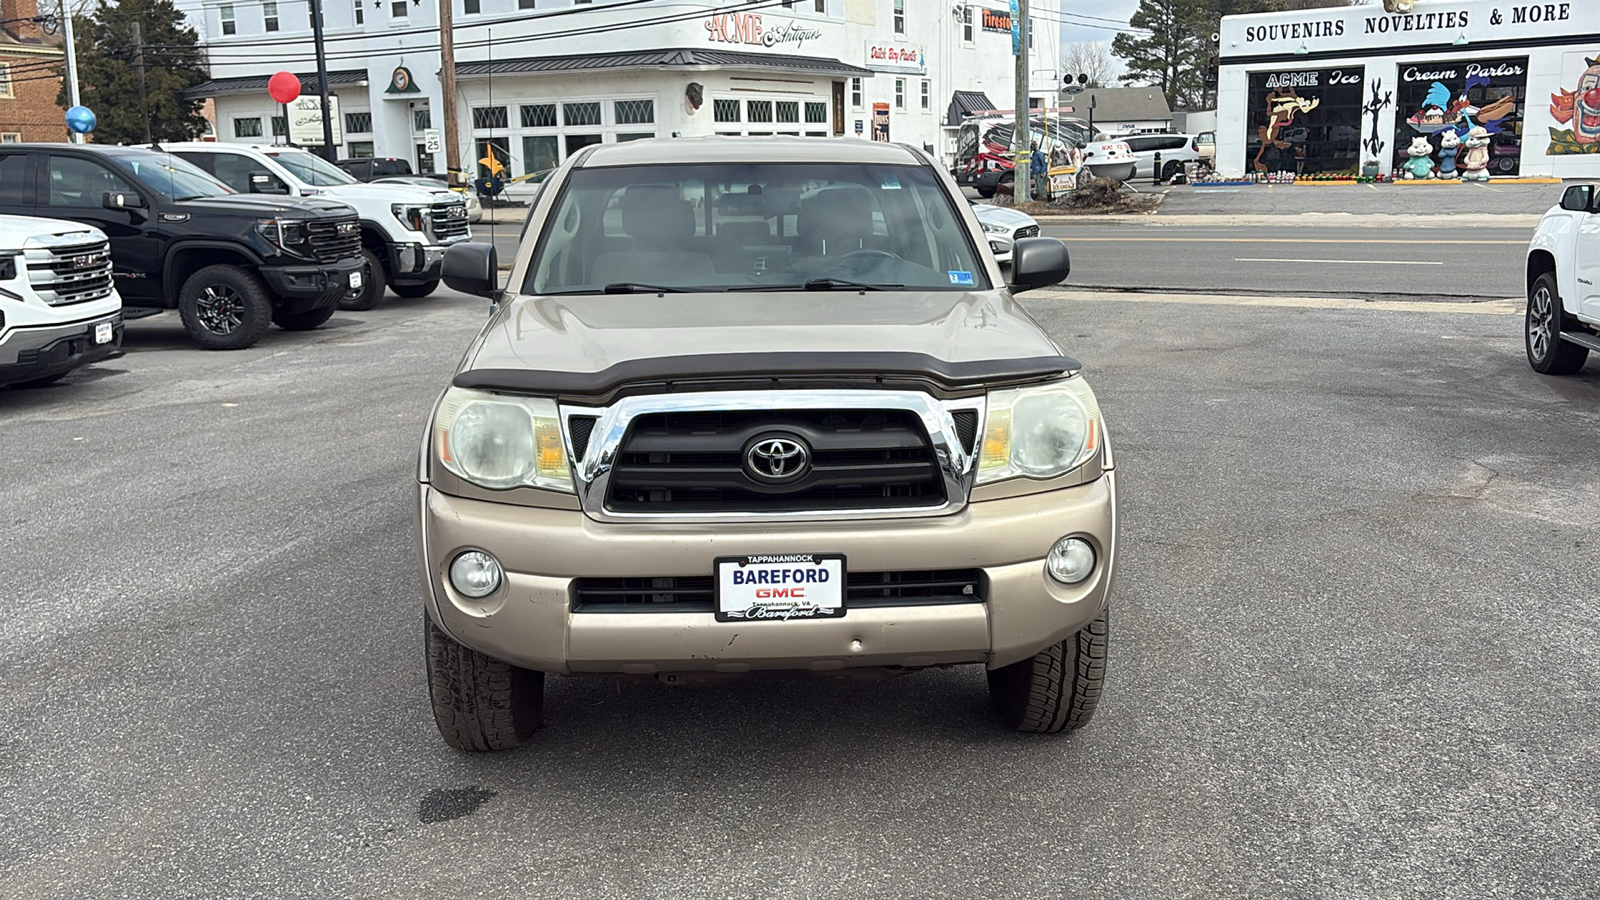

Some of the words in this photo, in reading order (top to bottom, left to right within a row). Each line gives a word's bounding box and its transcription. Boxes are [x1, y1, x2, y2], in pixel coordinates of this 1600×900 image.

[704, 10, 763, 45] ACME
[982, 9, 1011, 29] Firesto
[1246, 20, 1345, 42] SOUVENIRS
[1364, 11, 1469, 34] NOVELTIES
[1490, 8, 1503, 25] &
[1512, 3, 1570, 23] MORE
[871, 46, 886, 59] Dutch
[888, 47, 899, 63] Boy
[900, 48, 917, 62] Paints
[1266, 72, 1319, 88] ACME
[1328, 70, 1361, 85] Ice
[1403, 66, 1457, 82] Cream
[1465, 63, 1524, 79] Parlor
[427, 141, 440, 150] 25
[747, 555, 813, 564] TAPPAHANNOCK
[733, 568, 829, 585] BAREFORD
[755, 587, 805, 598] GMC
[745, 604, 818, 622] Bareford
